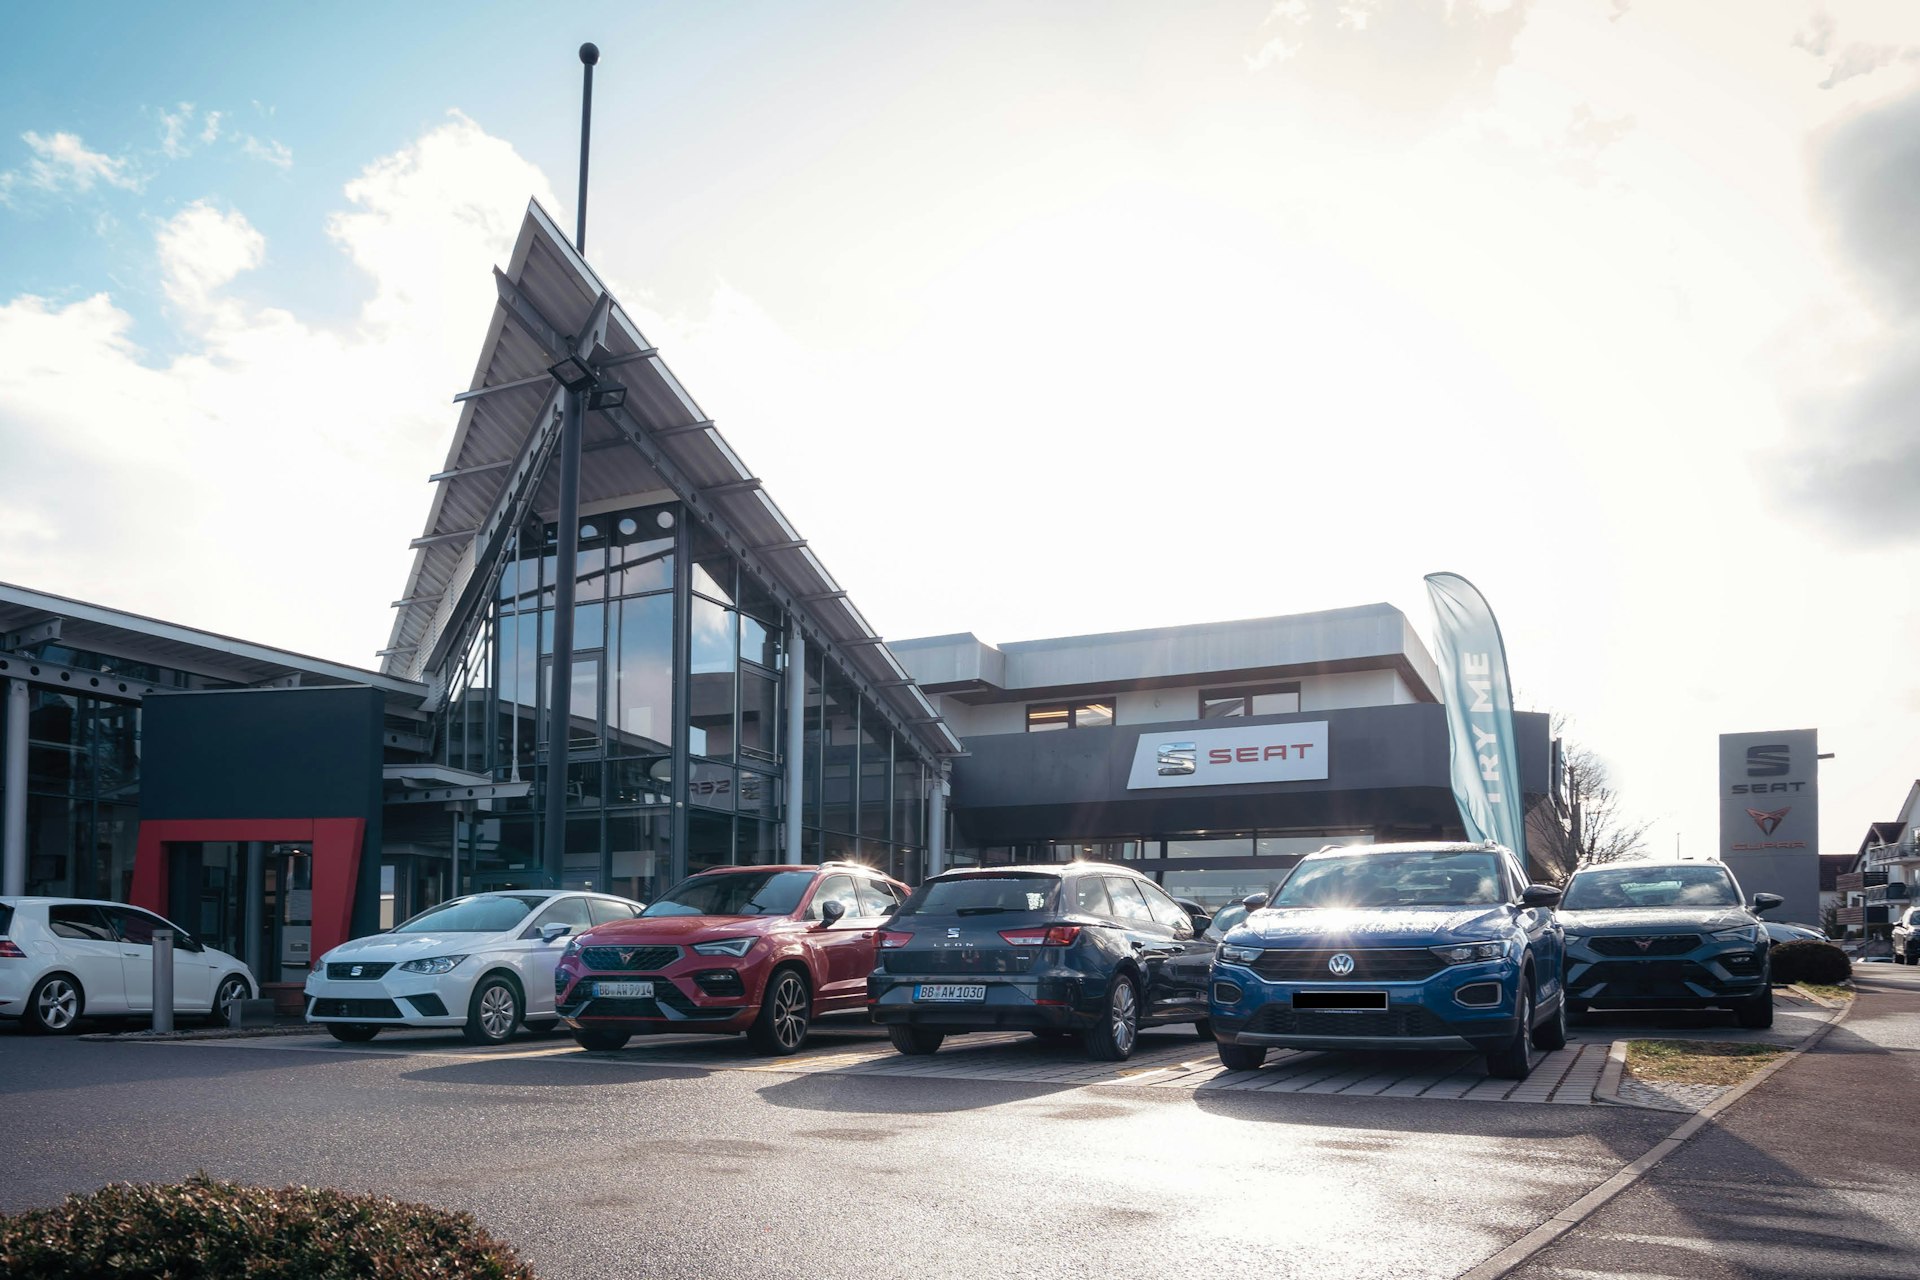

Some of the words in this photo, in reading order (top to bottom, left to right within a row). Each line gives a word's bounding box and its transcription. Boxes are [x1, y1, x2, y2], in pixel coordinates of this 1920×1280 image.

[1463, 651, 1494, 713] ME
[1208, 743, 1314, 765] SEAT
[1731, 781, 1807, 795] SEAT
[1731, 841, 1808, 851] CUPRA
[920, 986, 935, 998] BB
